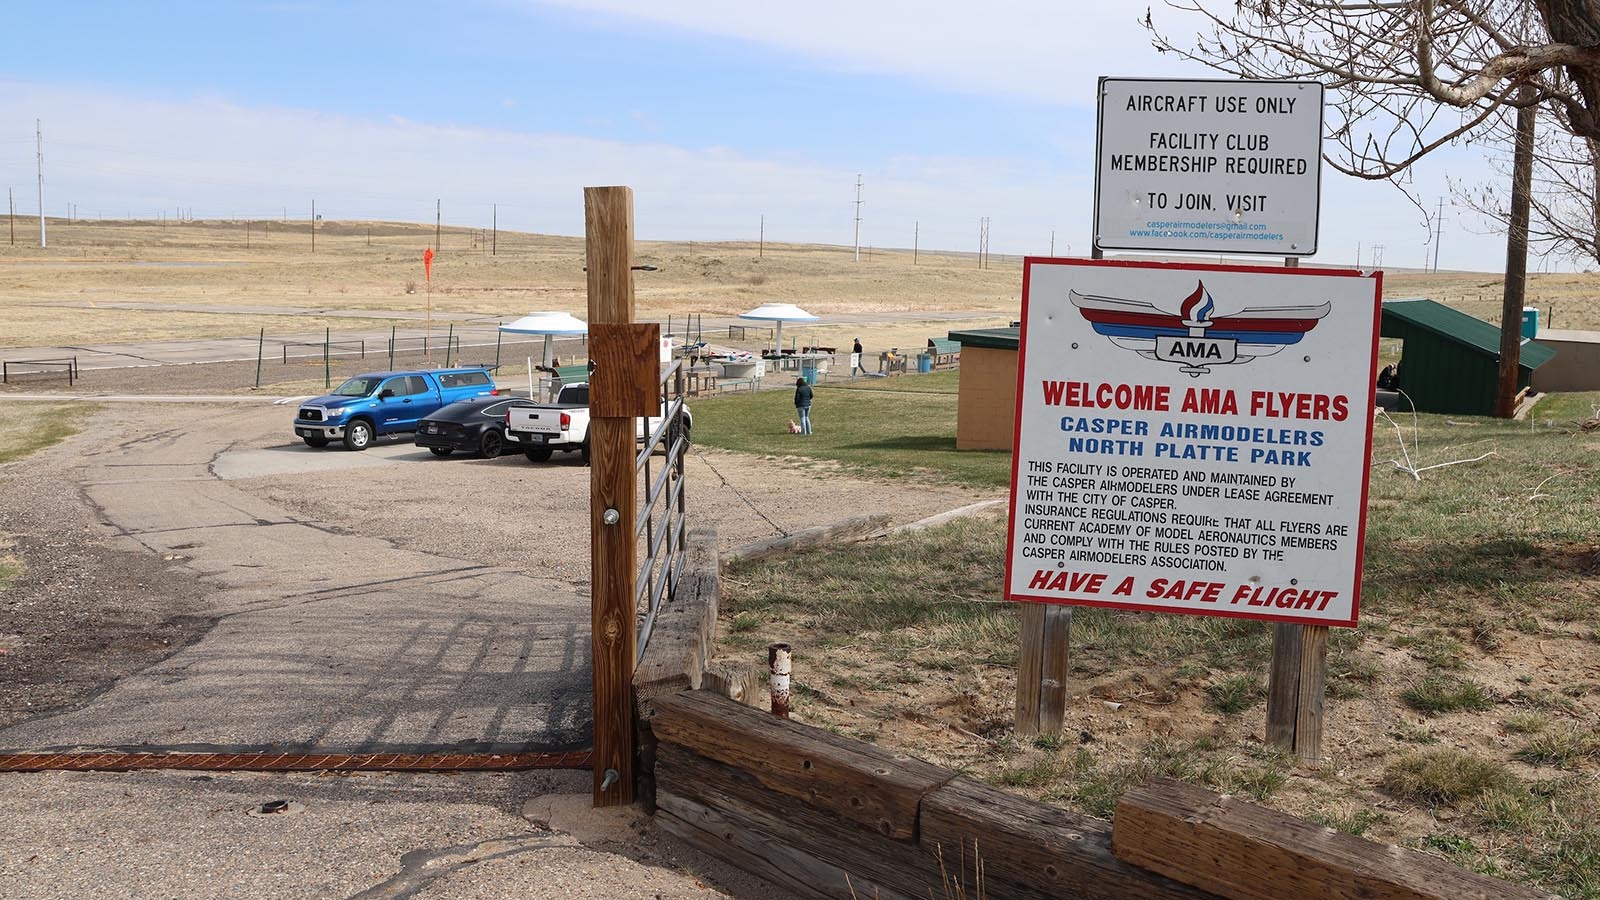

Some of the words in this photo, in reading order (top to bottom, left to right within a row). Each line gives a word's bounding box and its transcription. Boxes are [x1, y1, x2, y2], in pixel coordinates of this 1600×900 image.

[1126, 95, 1207, 112] AIRCRAFT
[1216, 96, 1247, 113] USE
[1256, 97, 1296, 114] ONLY
[1150, 132, 1219, 150] FACILITY
[1226, 134, 1269, 151] CLUB
[1111, 154, 1217, 173] MEMBERSHIP
[1226, 157, 1307, 175] REQUIRED
[1148, 192, 1167, 209] TO
[1226, 194, 1267, 212] VISIT
[1169, 341, 1222, 359] AMA
[1042, 380, 1170, 411] WELCOME
[1181, 387, 1238, 415] AMA
[1251, 391, 1348, 421] FLYERS
[1060, 416, 1149, 436] CASPER
[1160, 421, 1324, 447] AIRMODELERS
[1068, 437, 1144, 456] NORTH
[1155, 442, 1237, 462] PLATTE
[1251, 447, 1311, 466] PARK
[1028, 461, 1052, 473] THIS
[1057, 463, 1103, 476] FACILITY
[1107, 466, 1117, 477] IS
[1122, 466, 1179, 480] OPERATED
[1183, 470, 1206, 482] AND
[1210, 472, 1276, 487] MAINTAINED
[1281, 477, 1296, 488] BY
[1026, 490, 1053, 501] WITH
[1057, 491, 1078, 503] THE
[1083, 493, 1107, 505] CITY
[1111, 495, 1127, 506] OF
[1131, 496, 1177, 510] CASPER.
[1027, 475, 1048, 487] THE
[1052, 476, 1096, 490] CASPER
[1099, 480, 1178, 495] AIRMODELERS
[1182, 485, 1220, 498] UNDER
[1224, 488, 1260, 501] LEASE
[1264, 490, 1334, 506] AGREEMENT
[1025, 504, 1087, 518] INSURANCE
[1091, 508, 1167, 524] REGULATIONS
[1171, 513, 1219, 527] REQUIRE
[1224, 517, 1252, 529] THAT
[1255, 519, 1276, 531] ALL
[1280, 521, 1321, 535] FLYERS
[1325, 524, 1348, 536] ARE
[1023, 533, 1046, 544] AND
[1050, 534, 1093, 547] COMPLY
[1098, 537, 1124, 550] WITH
[1129, 539, 1150, 551] THE
[1154, 541, 1190, 555] RULES
[1194, 544, 1239, 558] POSTED
[1243, 548, 1258, 559] BY
[1262, 549, 1284, 561] THE
[1024, 518, 1075, 532] CURRENT
[1079, 522, 1132, 535] ACADEMY
[1136, 525, 1151, 537] OF
[1155, 527, 1194, 540] MODEL
[1198, 530, 1276, 546] AERONAUTICS
[1281, 536, 1337, 551] MEMBERS
[1022, 547, 1065, 560] CASPER
[1069, 550, 1146, 566] AIRMODELERS
[1151, 556, 1227, 572] ASSOCIATION.
[1028, 570, 1107, 593] HAVE
[1112, 576, 1134, 596] A
[1146, 578, 1225, 602] SAFE
[1230, 585, 1338, 610] FLIGHT
